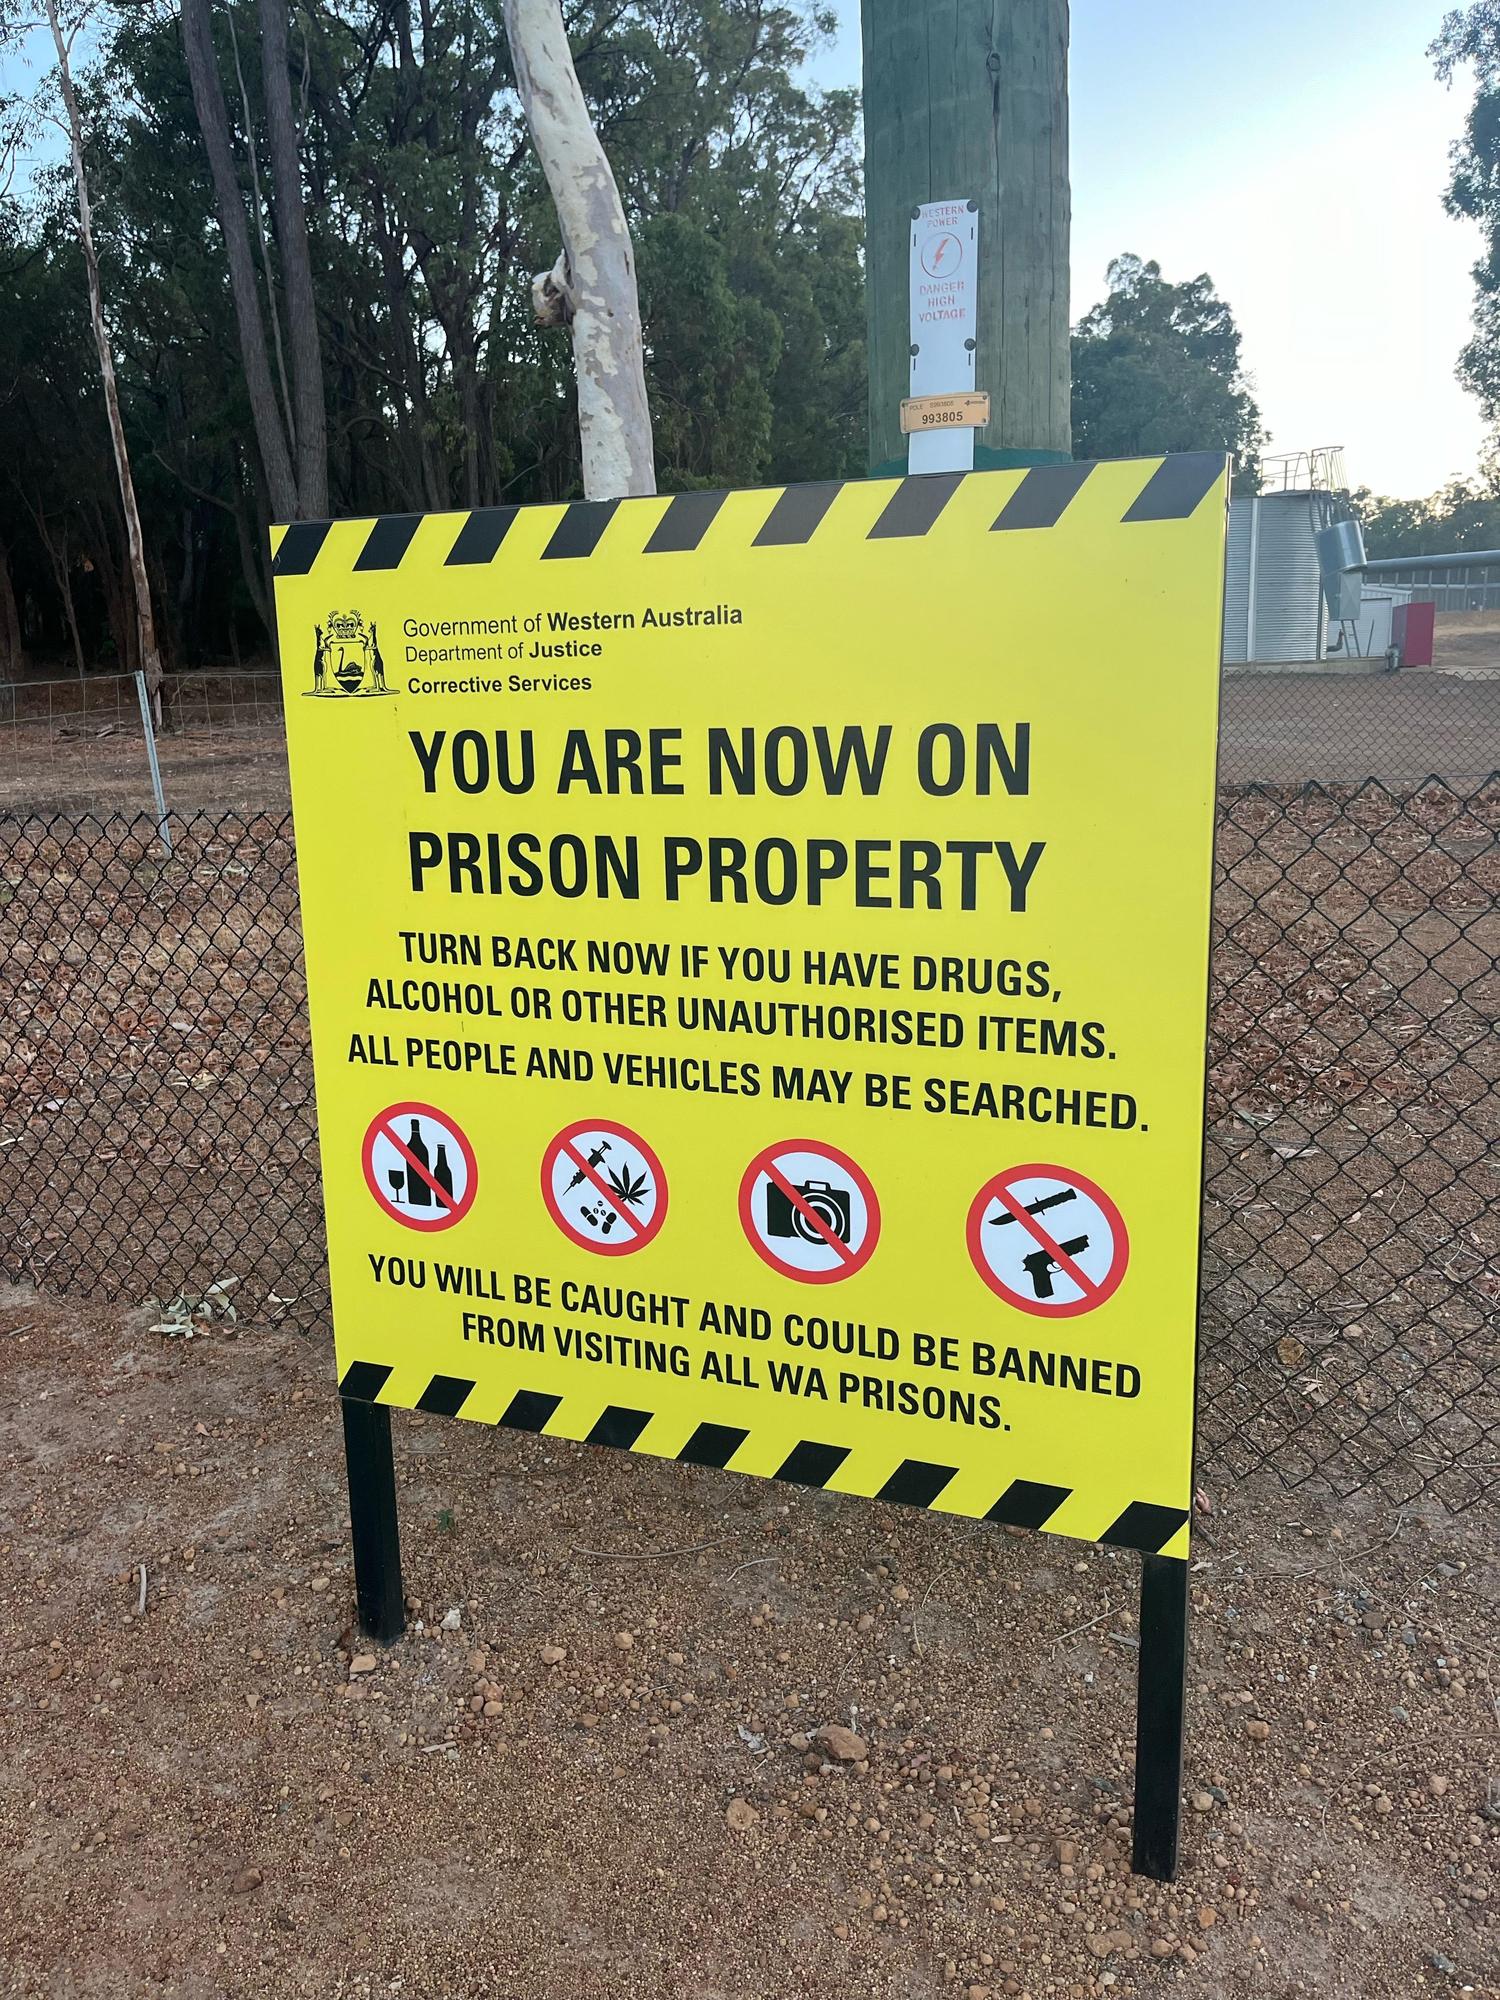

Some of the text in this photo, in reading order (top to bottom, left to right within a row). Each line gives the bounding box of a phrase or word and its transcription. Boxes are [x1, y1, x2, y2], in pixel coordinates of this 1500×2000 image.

[921, 205, 965, 219] WESTERN
[927, 217, 958, 228] POWER
[919, 281, 965, 296] DANGER
[928, 295, 956, 308] HIGH
[918, 308, 966, 323] VOLTAGE
[921, 411, 963, 424] 993805
[403, 604, 743, 638] Government of Western Australia
[405, 641, 603, 666] Department of Justice
[408, 675, 592, 694] Corrective Services
[407, 722, 1031, 797] YOU ARE NOW ON
[408, 831, 1047, 913] PRISON PROPERTY
[398, 931, 1062, 1003] TURN BACK NOW IF YOU HAVE DRUGS,
[366, 978, 1116, 1060] ALCOHOL OR OTHER UNAUTHORISED ITEMS.
[348, 1033, 1148, 1132] ALL PEOPLE AND VEHICLES MAY BE SEARCHED.
[367, 1253, 1141, 1399] YOU WILL BE CAUGHT AND COULD BE BANNED
[462, 1311, 1011, 1432] FROM VISITING ALL WA PRISONS.
